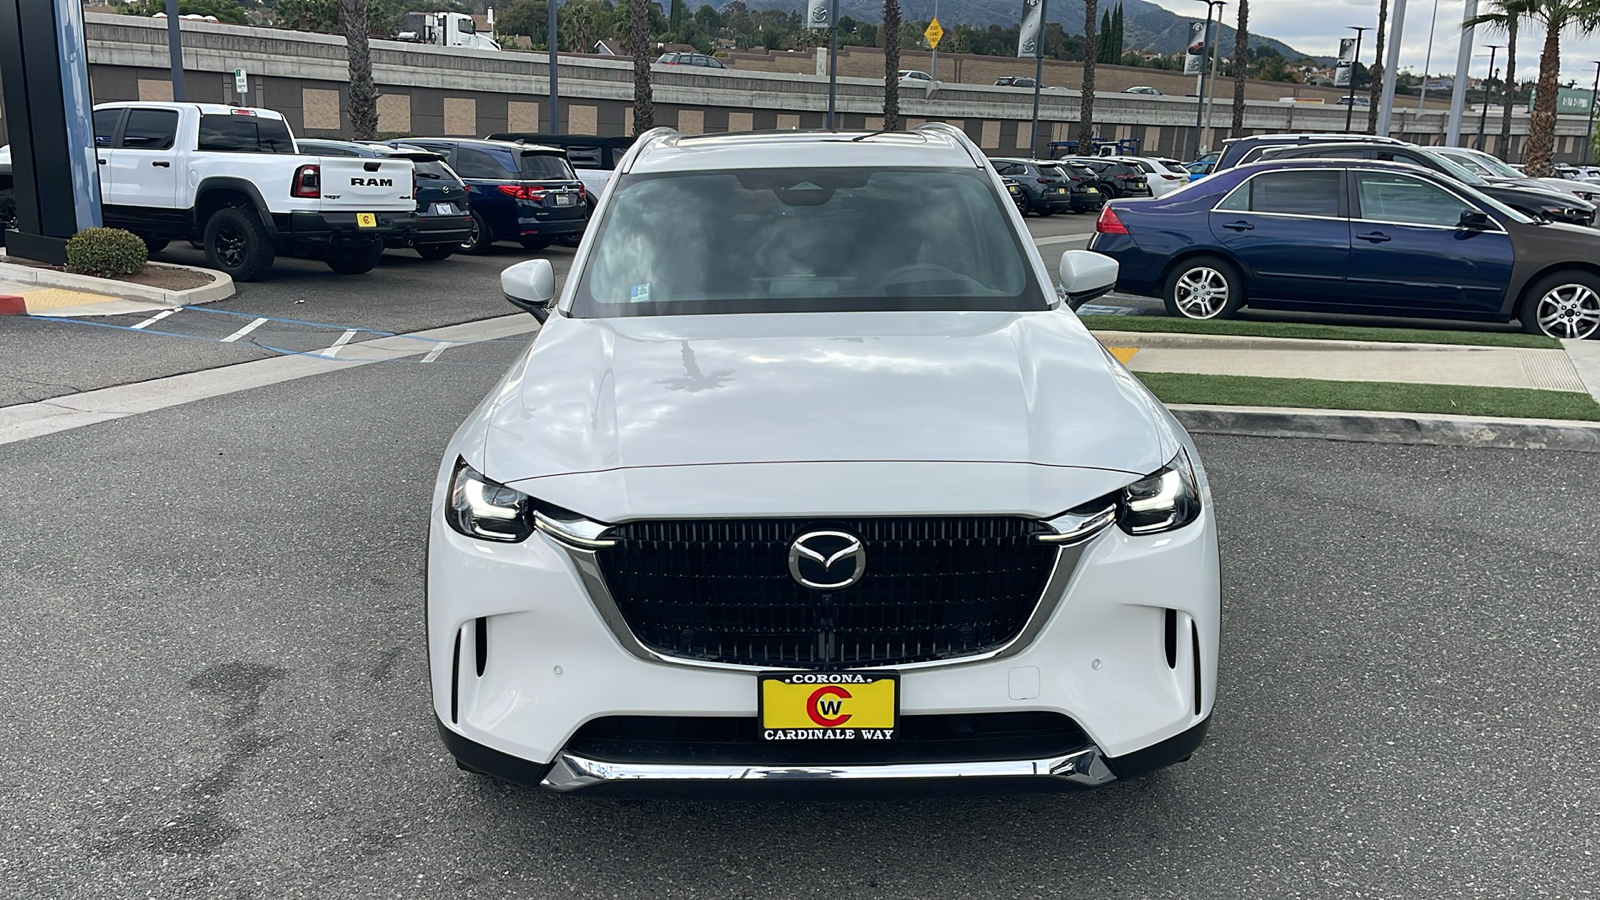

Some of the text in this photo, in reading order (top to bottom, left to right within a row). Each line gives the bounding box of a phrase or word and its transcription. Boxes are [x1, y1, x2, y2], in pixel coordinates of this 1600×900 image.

[350, 177, 393, 187] RAM
[792, 674, 866, 684] CORONA
[819, 698, 843, 716] W
[763, 729, 894, 740] CARDINALE WAY
